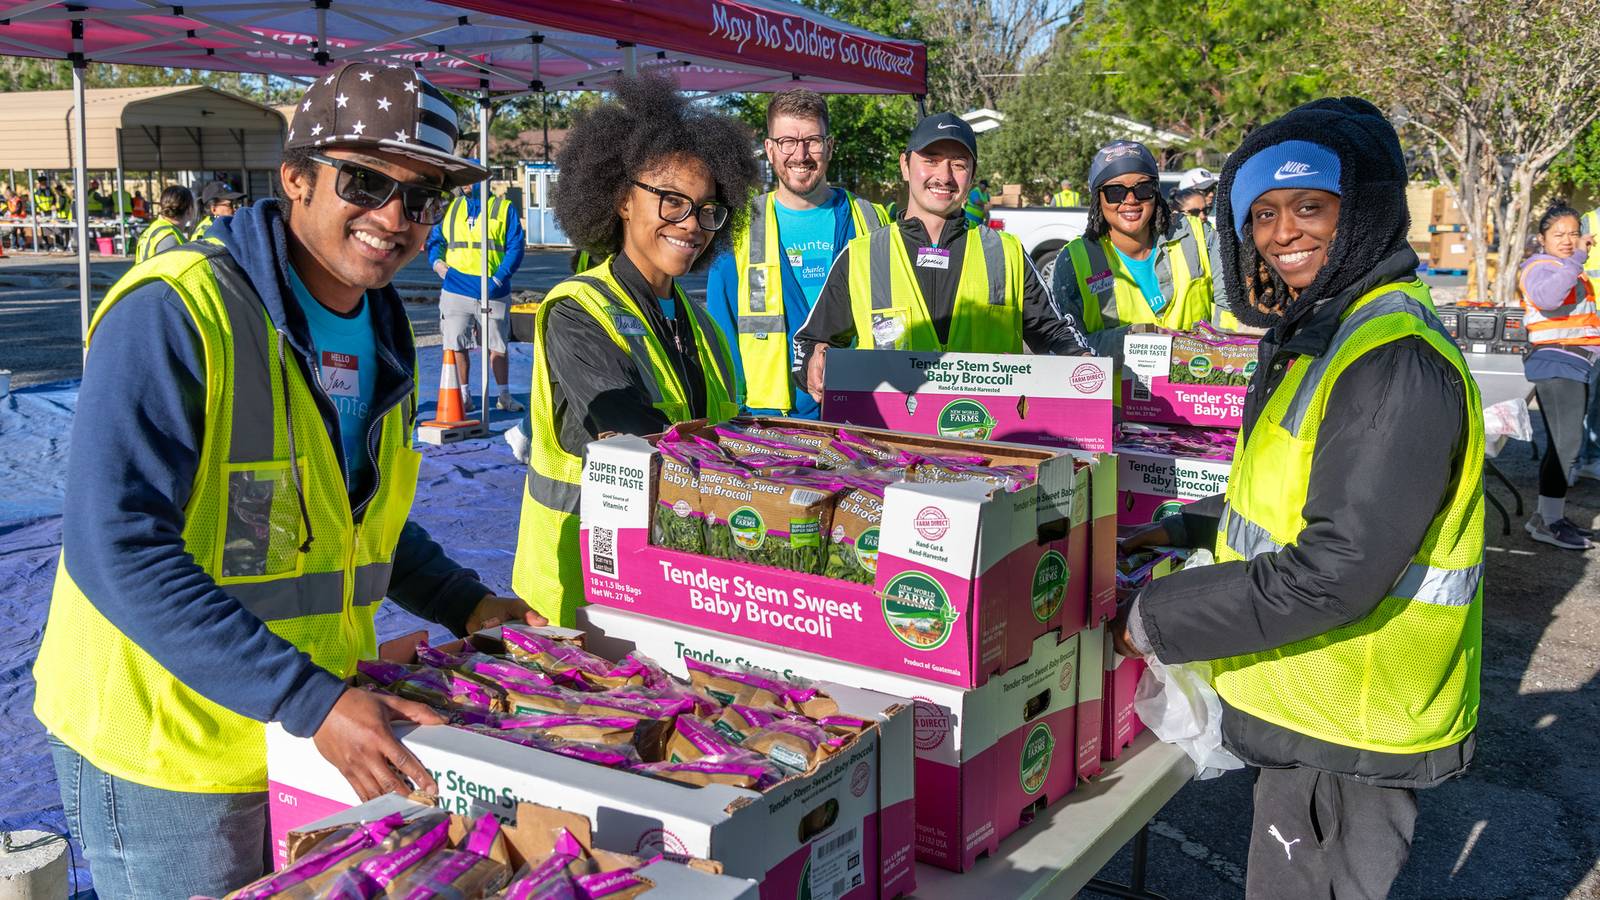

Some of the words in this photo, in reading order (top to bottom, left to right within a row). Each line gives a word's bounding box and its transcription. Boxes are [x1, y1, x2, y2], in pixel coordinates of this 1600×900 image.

[709, 4, 751, 53] May
[756, 15, 781, 48] No
[783, 18, 836, 60] Soldier
[839, 34, 859, 65] Go
[1281, 161, 1310, 173] NIKE
[330, 352, 350, 363] HELLO
[909, 358, 954, 370] Tender
[956, 360, 990, 372] Stem
[992, 362, 1032, 374] Sweet
[926, 370, 960, 385] Baby
[962, 372, 1013, 386] Broccoli
[1086, 374, 1104, 382] DIRECT
[1176, 390, 1222, 404] Tender
[1224, 393, 1245, 405] Ste
[950, 414, 980, 422] FARMS
[1194, 403, 1228, 419] Baby
[745, 444, 770, 455] Stem
[590, 461, 617, 474] SUPER
[620, 466, 644, 479] FOOD
[1128, 460, 1167, 475] Tender
[1169, 465, 1198, 479] Stem
[1201, 470, 1230, 483] Swee
[589, 472, 616, 486] SUPER
[618, 477, 644, 491] TASTE
[664, 470, 688, 487] Baby
[1143, 473, 1171, 488] Baby
[1174, 478, 1219, 493] Broccoli
[700, 484, 714, 496] aby
[714, 485, 752, 502] Broccoli
[752, 481, 785, 495] Sweet
[1042, 491, 1060, 502] Sweet
[1061, 488, 1076, 497] Baby
[603, 501, 624, 511] Vitamin
[840, 499, 851, 512] by
[866, 499, 884, 512] Ste
[916, 540, 939, 552] Hand-Cut
[908, 548, 948, 563] Hand-Harvested
[591, 578, 598, 586] 18
[615, 583, 624, 591] lbs
[626, 585, 641, 596] Bags
[659, 560, 729, 593] Tender
[733, 576, 789, 606] Stem
[793, 588, 863, 622] Sweet
[899, 584, 912, 593] NEW
[913, 587, 936, 598] WORLD
[592, 588, 603, 597] Net
[603, 590, 614, 599] Wt.
[624, 594, 634, 603] lbs
[898, 591, 935, 610] FARMS
[690, 589, 741, 623] Baby
[745, 600, 833, 639] Broccoli
[904, 657, 924, 668] Product
[932, 664, 961, 676] Guatemala
[1003, 679, 1021, 693] Tender
[920, 718, 947, 728] DIRECT
[447, 770, 496, 804] Stem
[278, 792, 298, 806] CAT1
[769, 792, 792, 815] Tender
